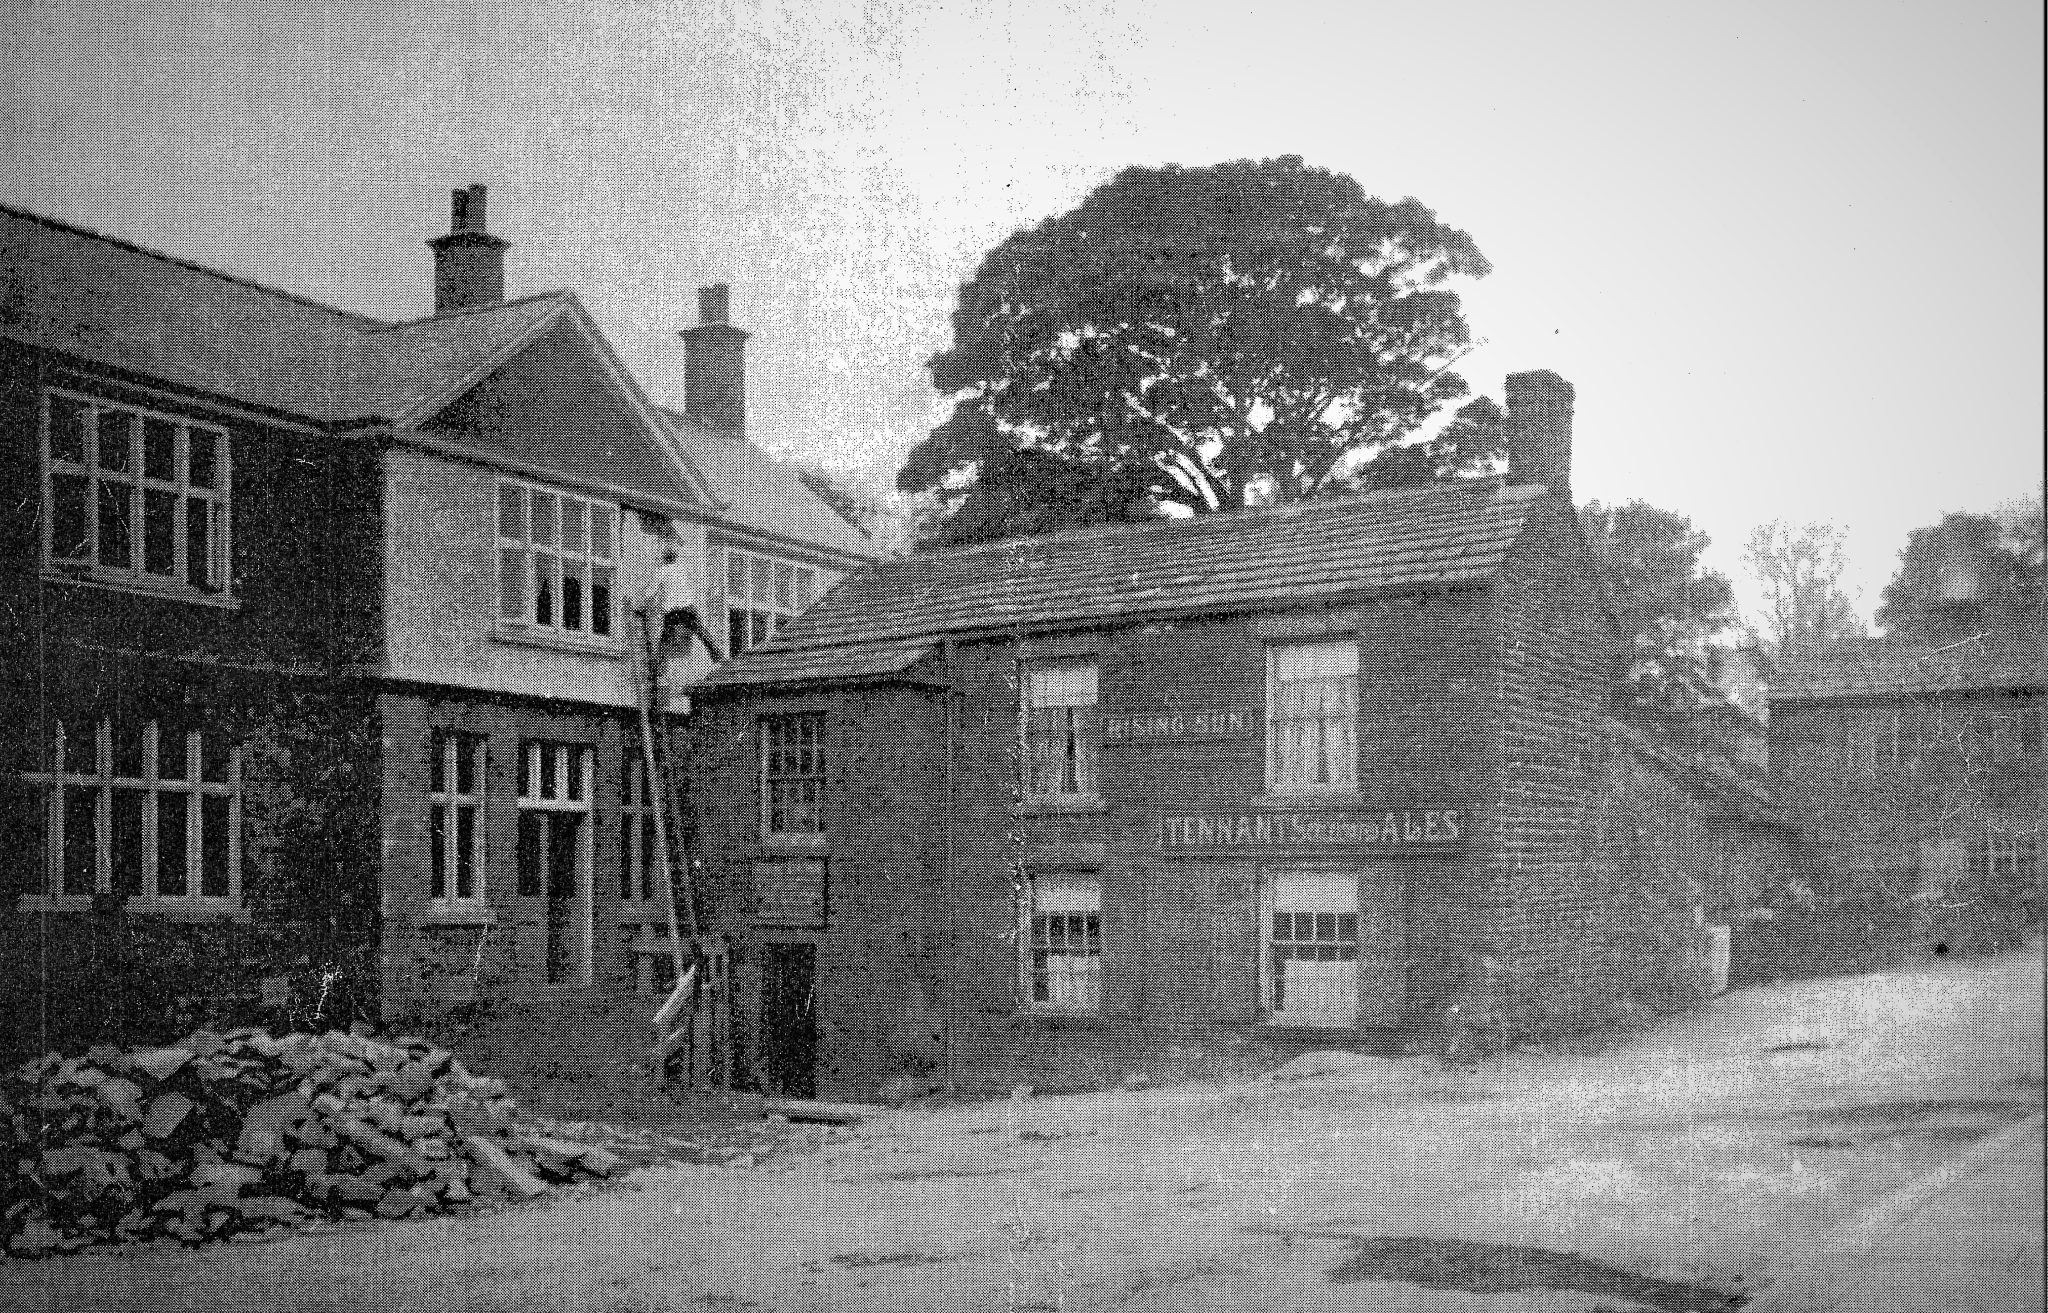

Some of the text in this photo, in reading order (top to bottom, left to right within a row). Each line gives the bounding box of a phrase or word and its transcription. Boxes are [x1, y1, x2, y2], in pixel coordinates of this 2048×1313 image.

[1107, 711, 1244, 739] RISING SUN
[1380, 810, 1460, 844] ALES
